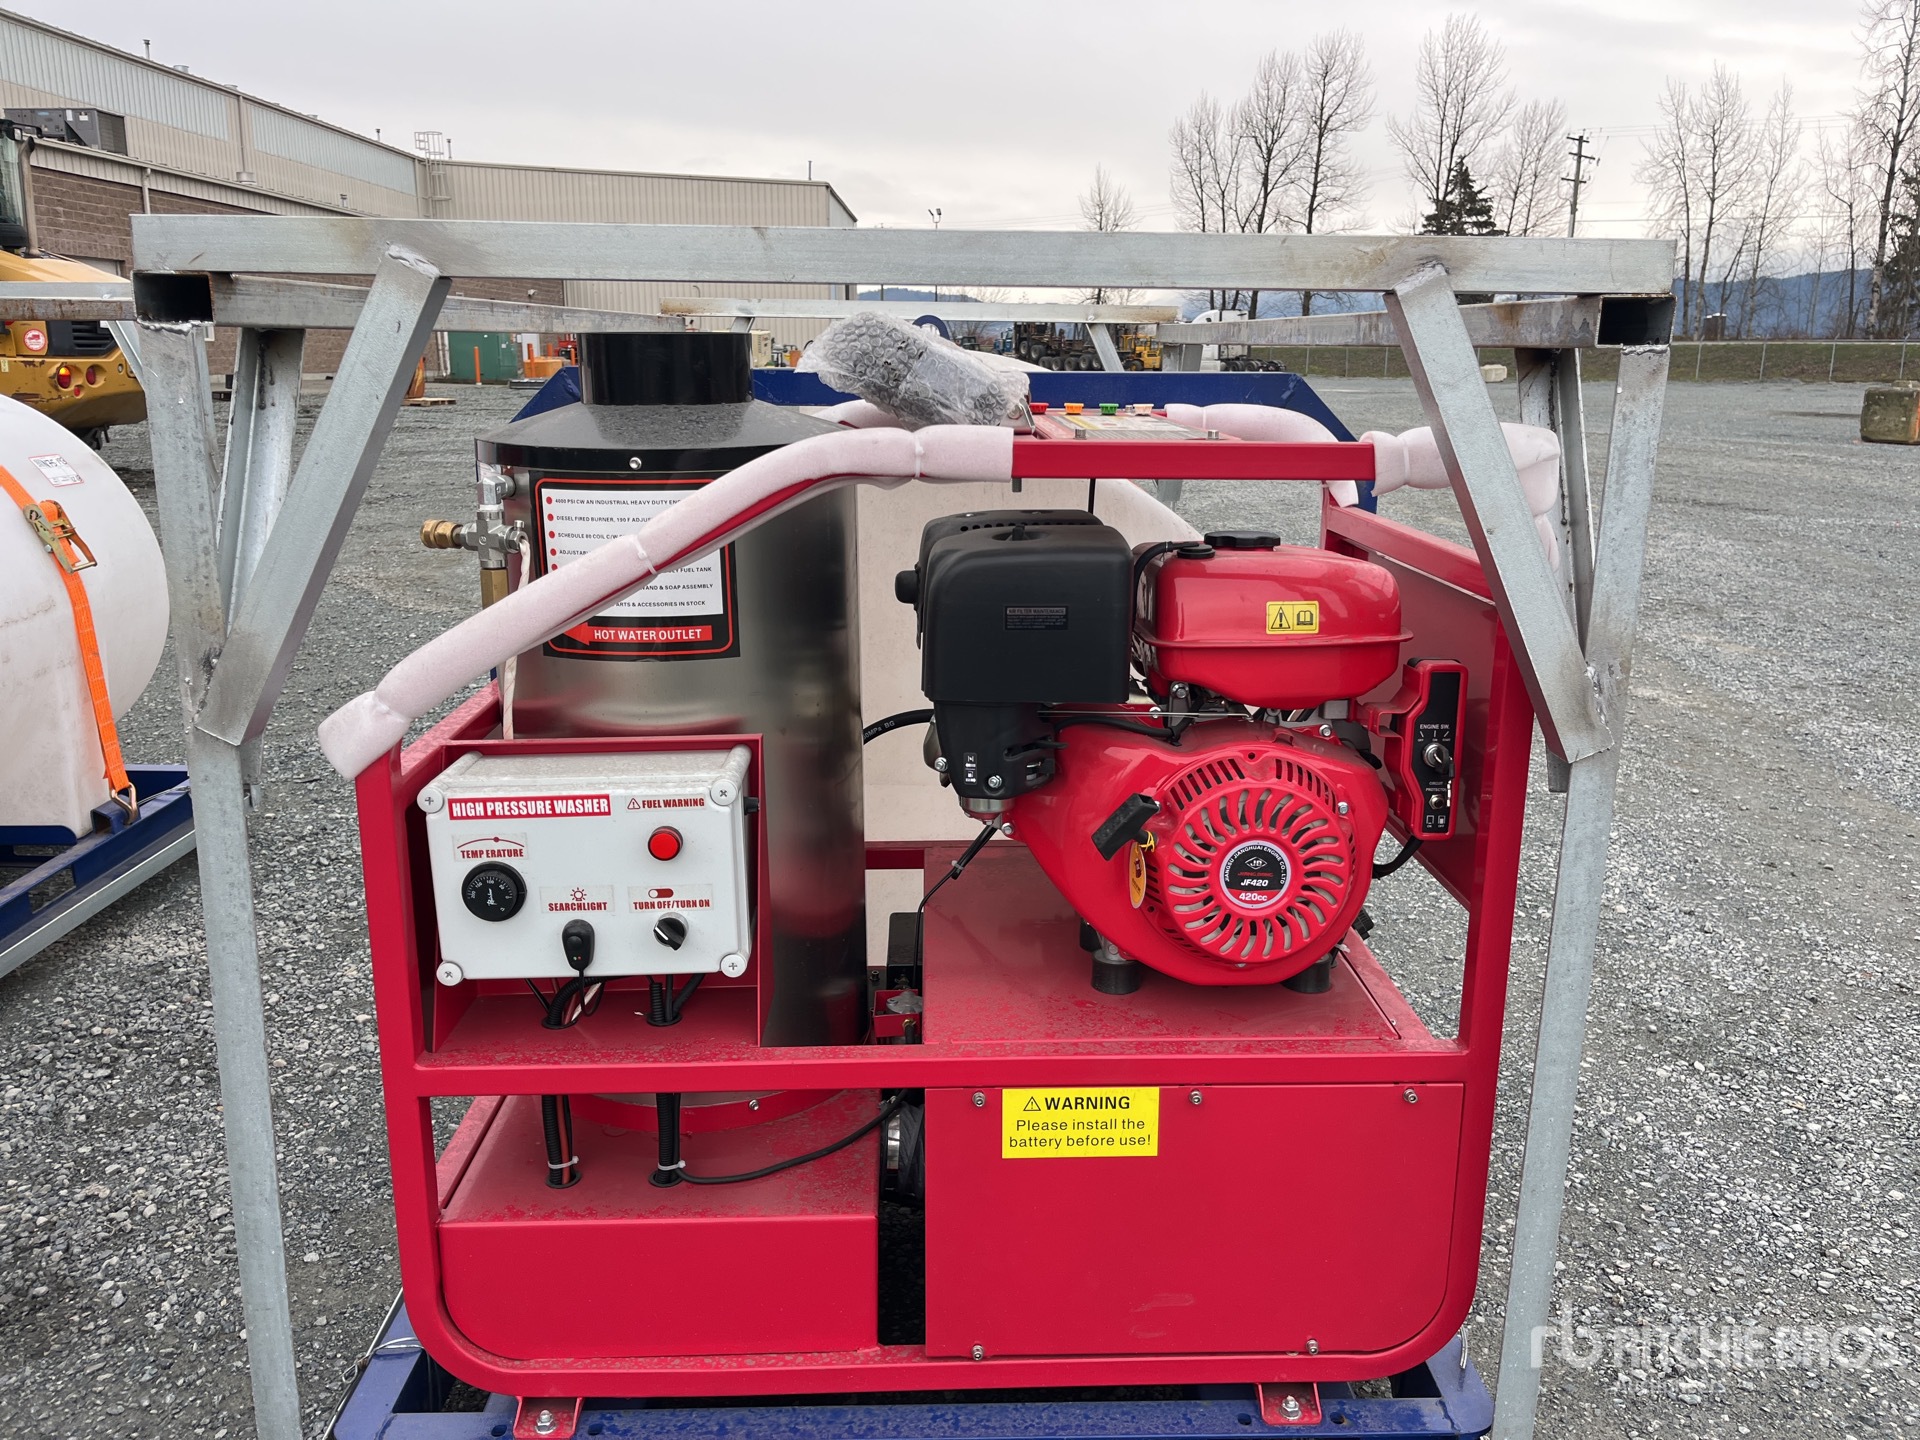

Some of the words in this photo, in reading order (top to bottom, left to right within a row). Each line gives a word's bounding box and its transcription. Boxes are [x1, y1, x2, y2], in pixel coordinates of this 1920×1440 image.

[594, 629, 615, 640] HOT
[618, 630, 656, 641] WATER
[658, 628, 702, 640] OUTLET
[452, 801, 485, 817] HIGH
[487, 800, 553, 816] PRESSURE
[552, 798, 609, 814] WASHER
[642, 800, 662, 809] FUEL
[663, 798, 705, 808] WARNING
[1264, 846, 1282, 862] ENGINE
[1239, 892, 1268, 901] 420cc
[548, 902, 608, 912] SEARCHLIGHT
[633, 901, 656, 910] TURN
[657, 900, 698, 910] OFF/TURN
[698, 899, 710, 908] ON
[1044, 1096, 1130, 1110] WARNING
[1016, 1119, 1068, 1131] Please
[1072, 1118, 1118, 1130] install
[1122, 1118, 1146, 1130] the
[1009, 1136, 1062, 1150] battery
[1066, 1134, 1115, 1146] before
[1119, 1134, 1152, 1146] use!
